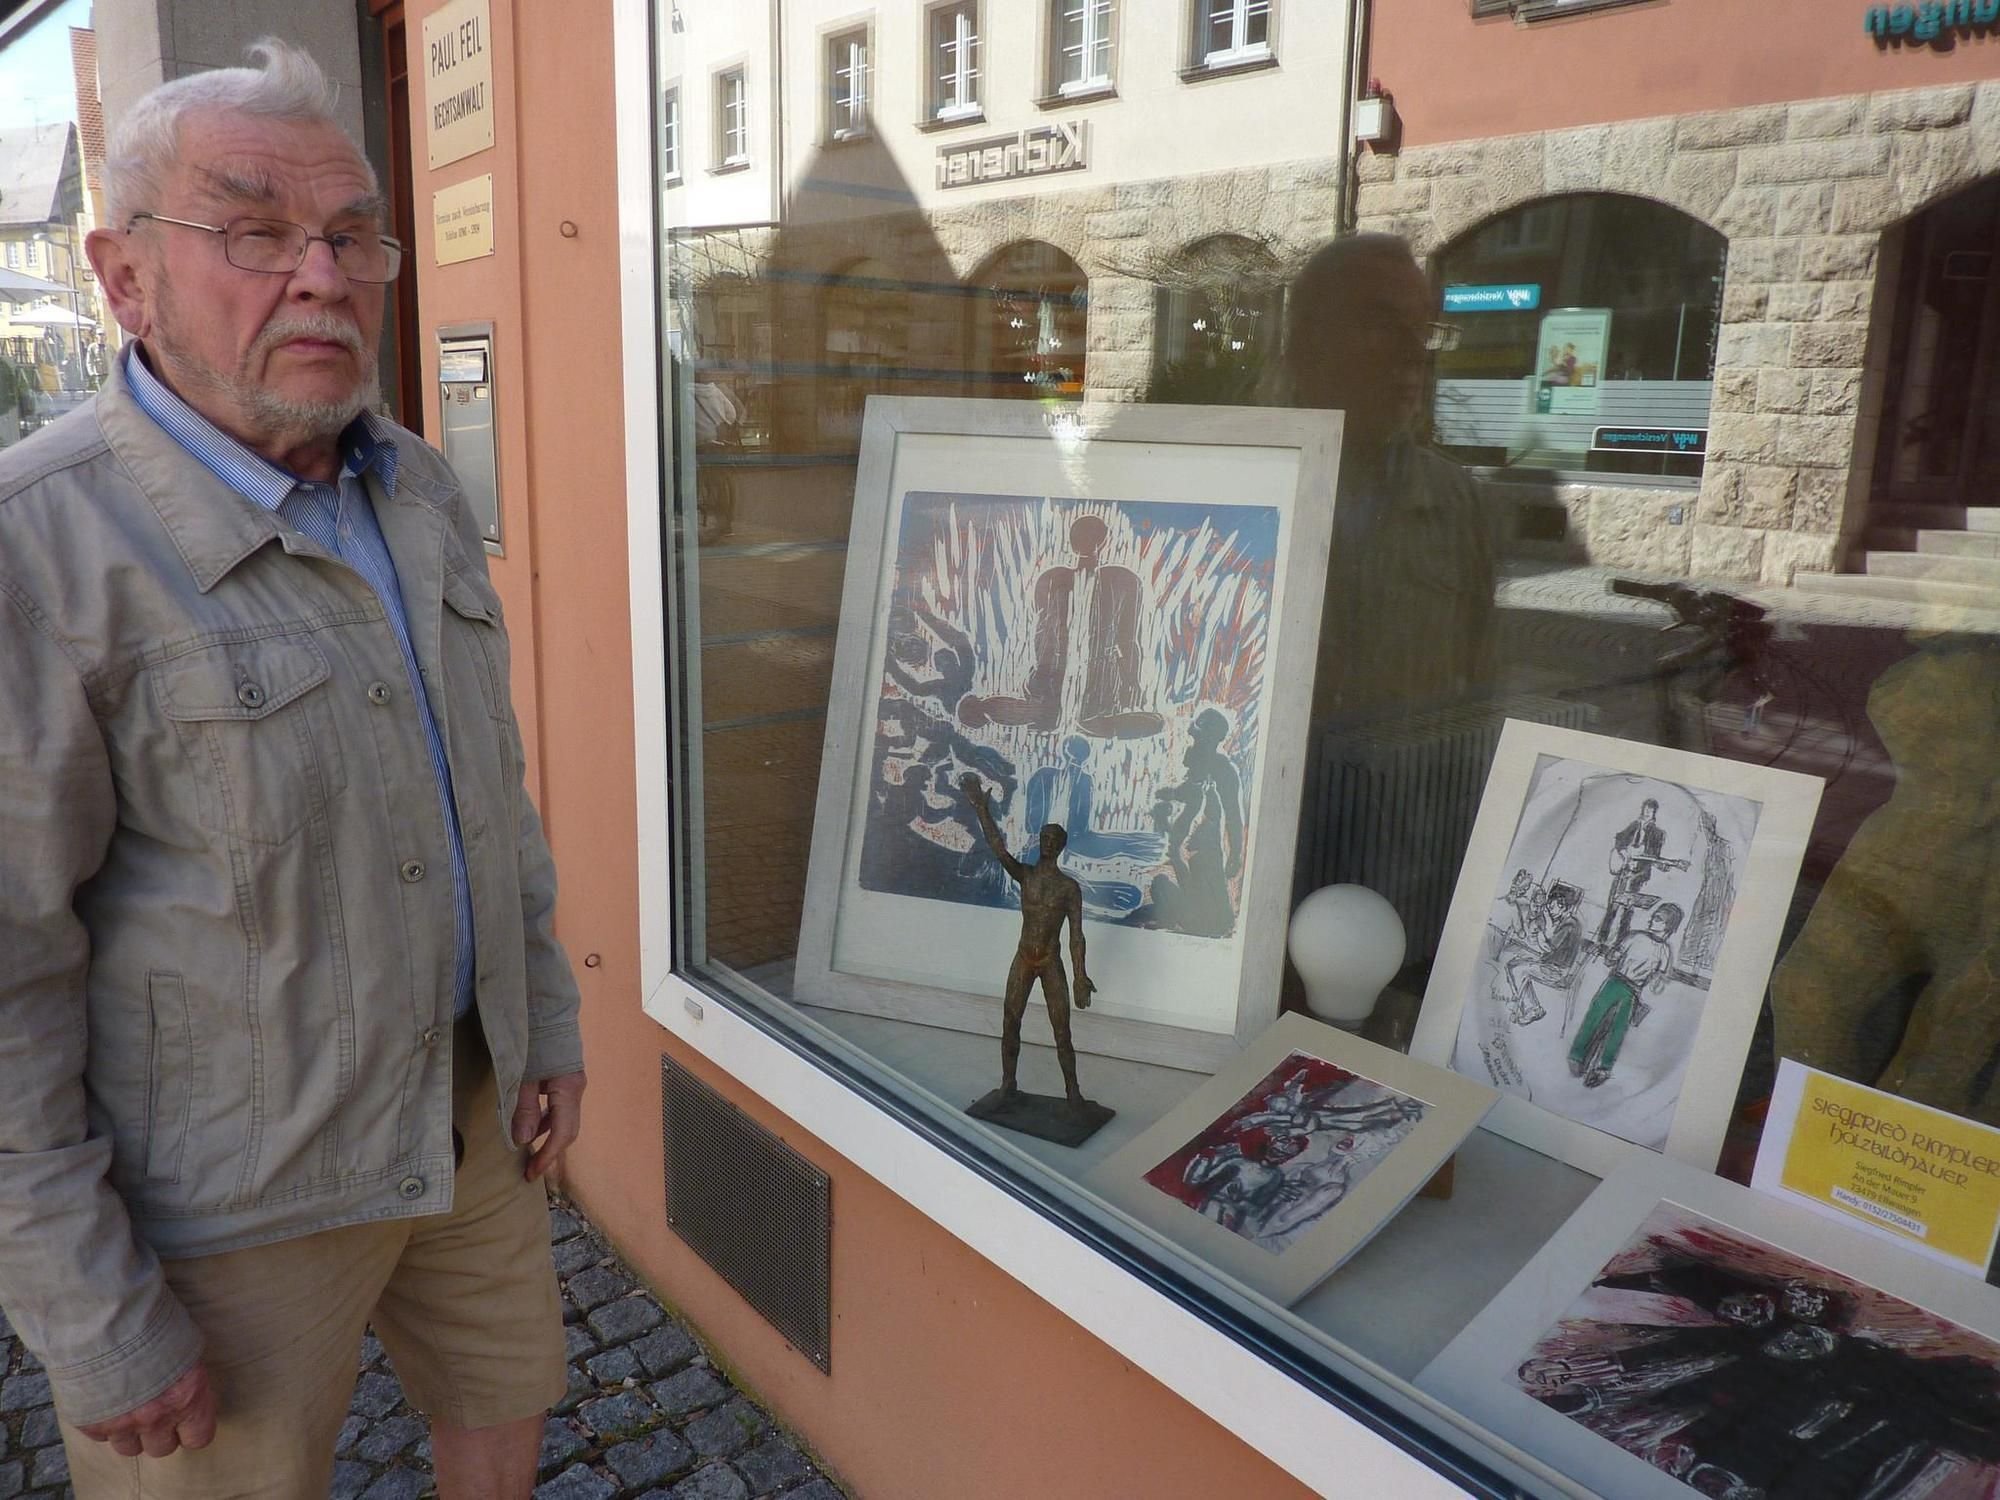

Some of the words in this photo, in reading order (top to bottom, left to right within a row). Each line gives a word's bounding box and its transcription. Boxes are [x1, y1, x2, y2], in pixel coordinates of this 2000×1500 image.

[431, 31, 457, 78] PAUL
[459, 16, 483, 62] FEIL
[434, 82, 485, 132] RECHTSANWALT
[1852, 1173, 1865, 1183] An
[1855, 1161, 1892, 1182] Siegfried
[1893, 1175, 1927, 1195] Rimpler
